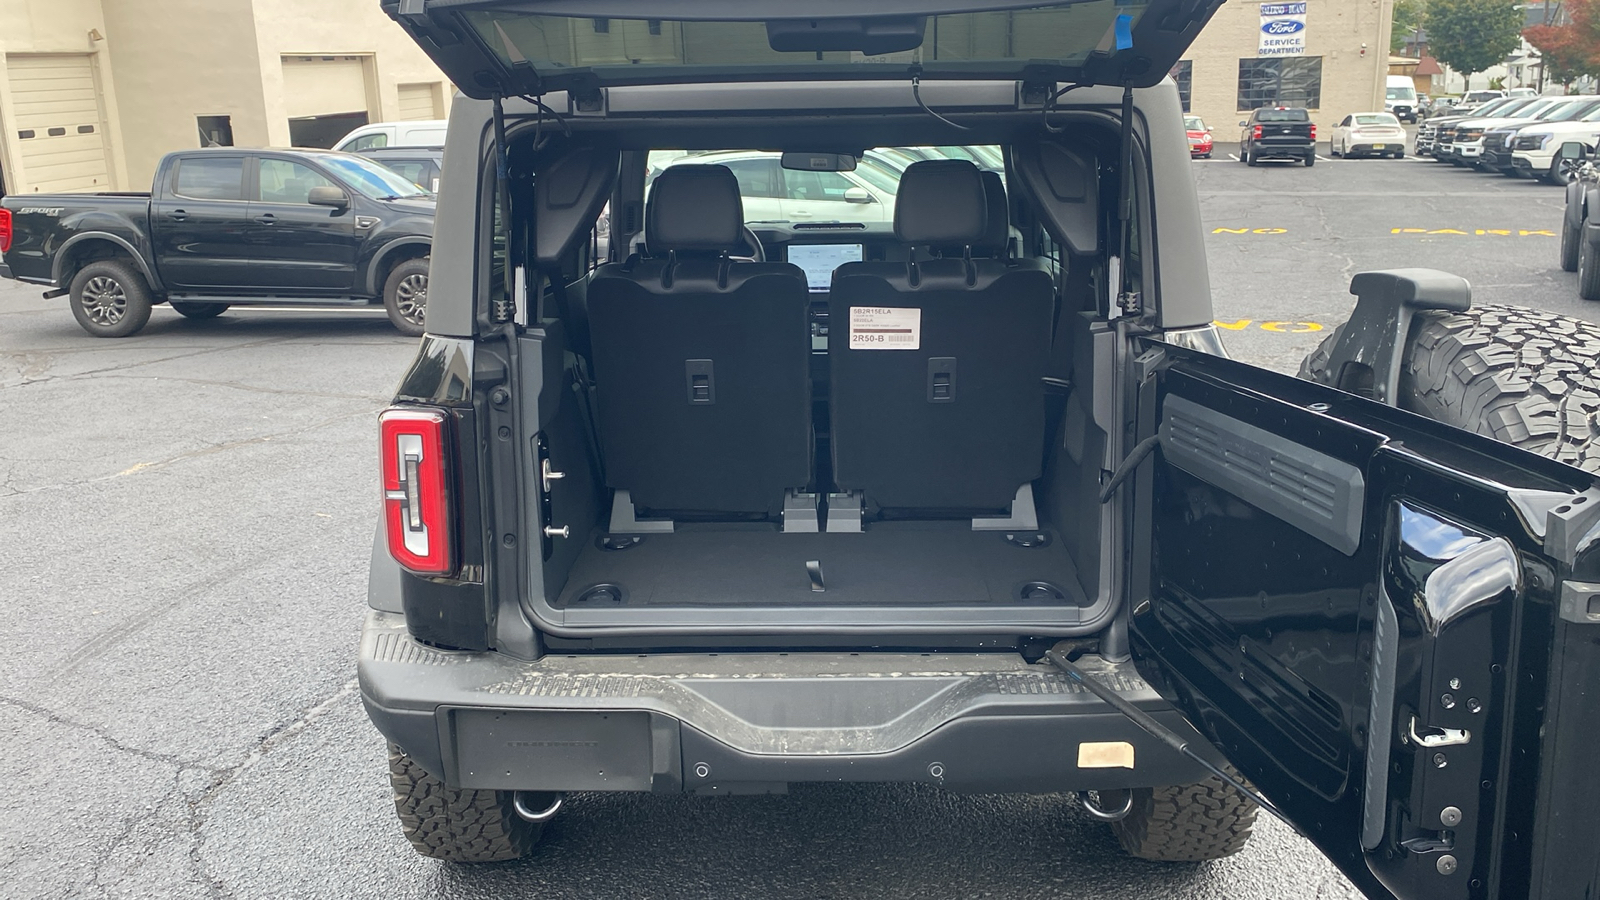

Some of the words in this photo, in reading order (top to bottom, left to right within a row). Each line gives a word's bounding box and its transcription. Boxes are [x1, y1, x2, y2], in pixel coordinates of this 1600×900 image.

[1269, 21, 1297, 33] Ford
[1263, 38, 1300, 46] SERVICE
[1258, 47, 1305, 55] DEPARTMENT
[16, 207, 65, 215] SPORT
[1211, 227, 1288, 235] NO
[852, 334, 885, 342] 2R50-B
